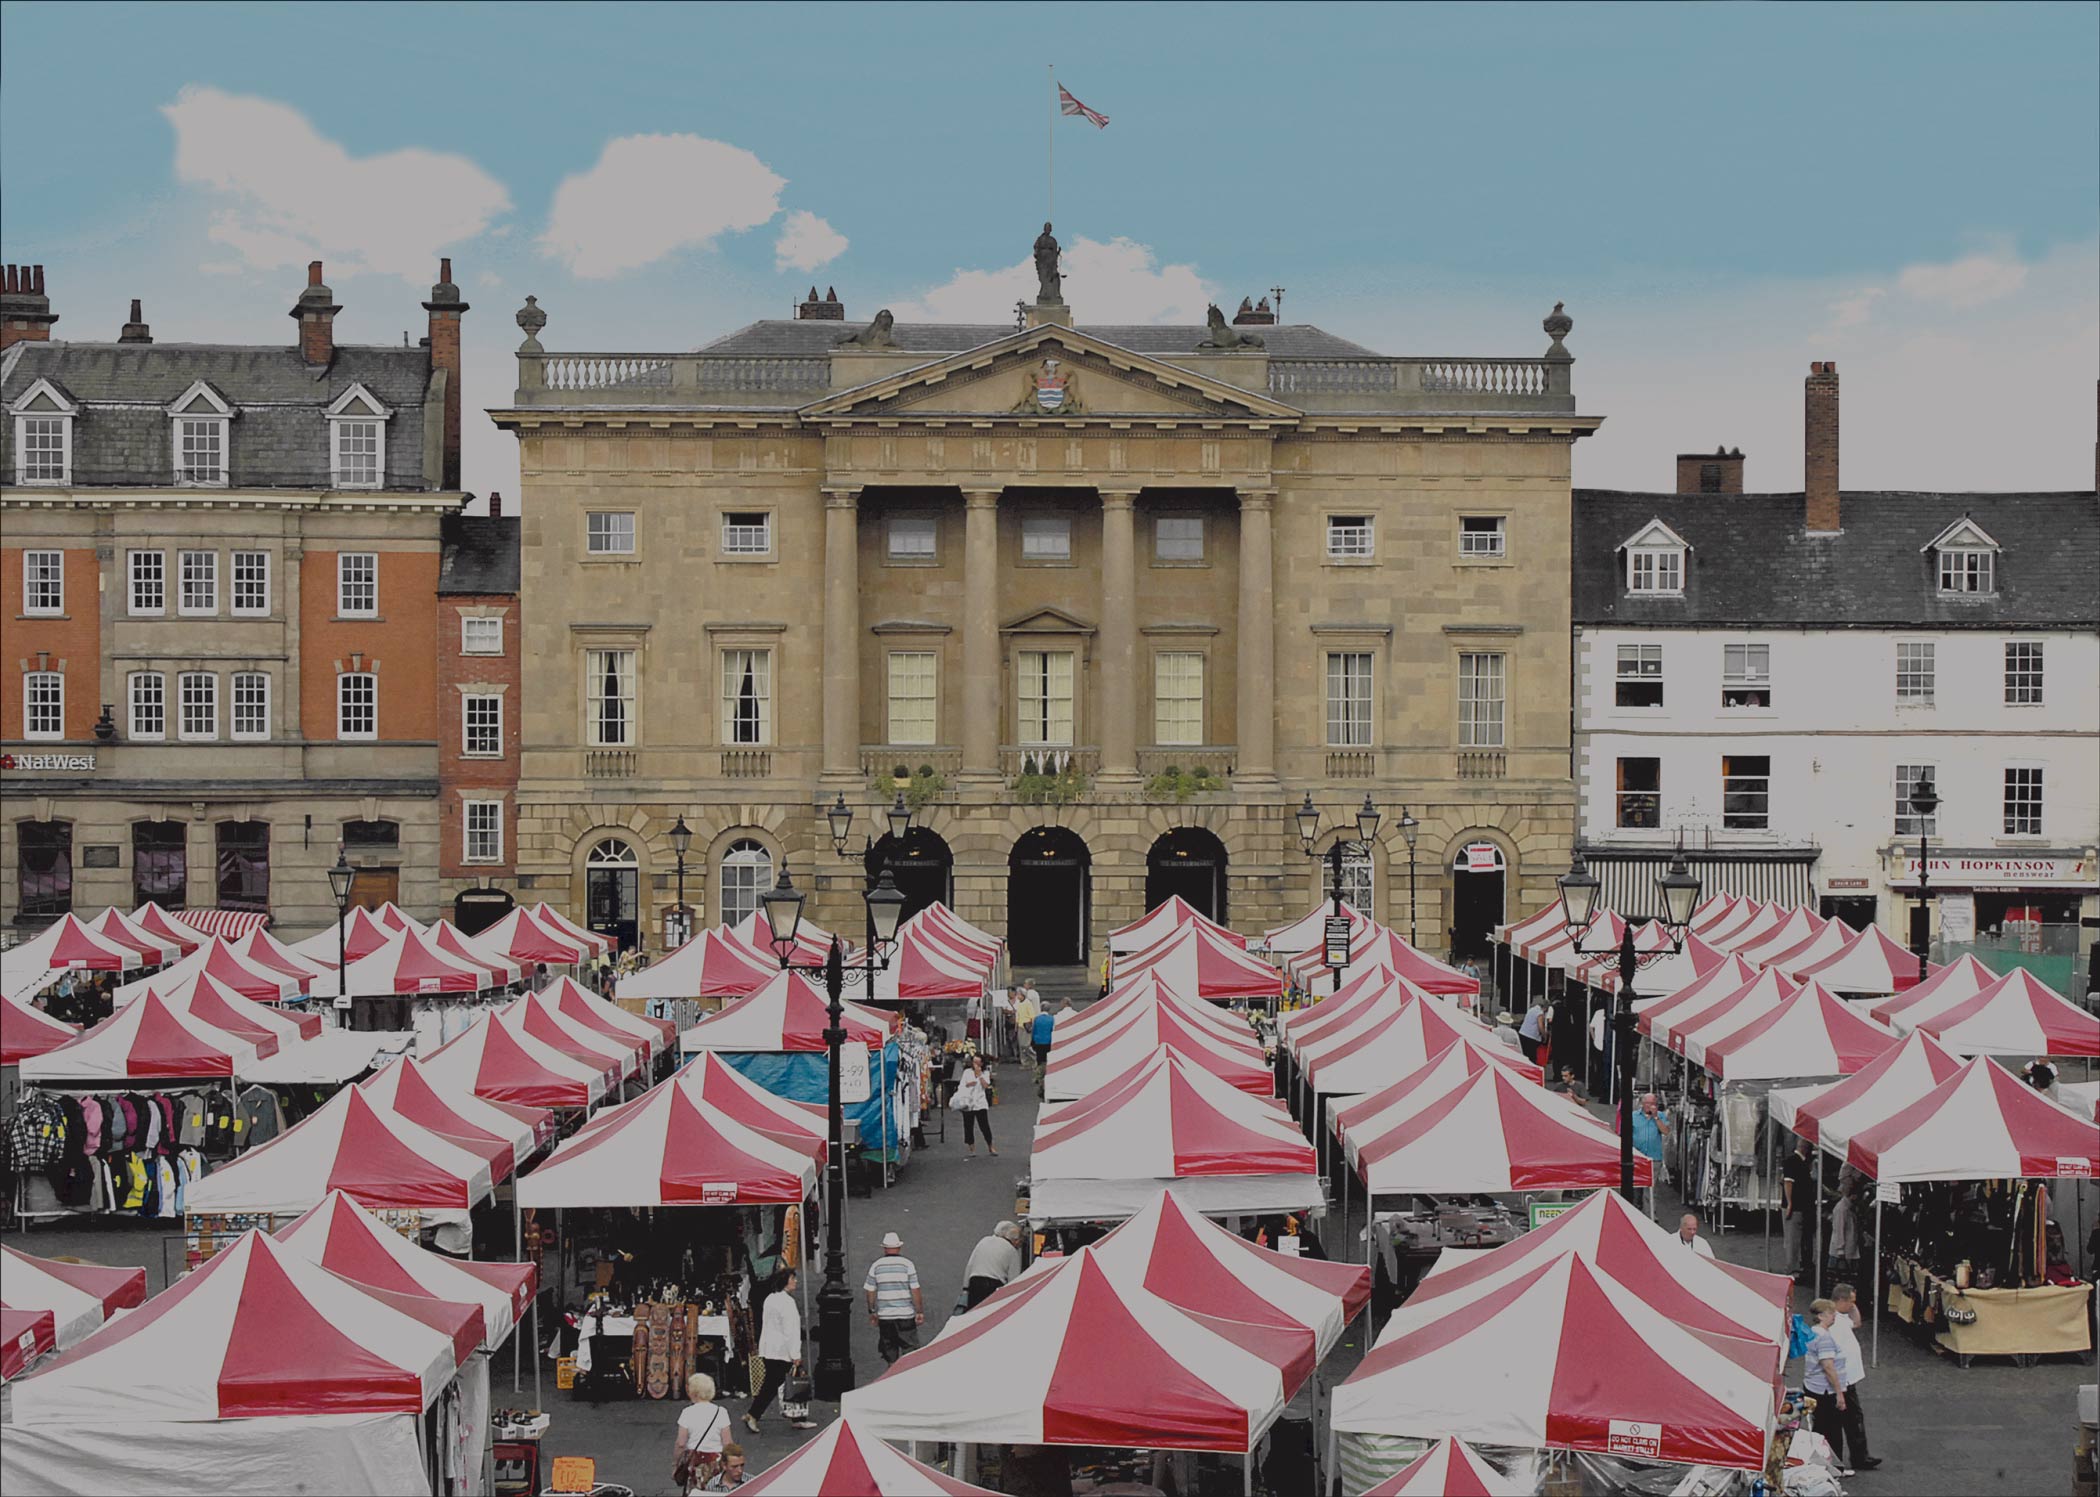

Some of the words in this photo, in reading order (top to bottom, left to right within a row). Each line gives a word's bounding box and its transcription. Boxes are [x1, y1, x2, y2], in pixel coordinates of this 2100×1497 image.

[19, 754, 96, 770] NatWest
[1960, 860, 2055, 871] HOPKINSON
[1621, 1436, 1632, 1444] NOT
[1613, 1443, 1634, 1452] MARKET
[1635, 1446, 1655, 1455] STALLS
